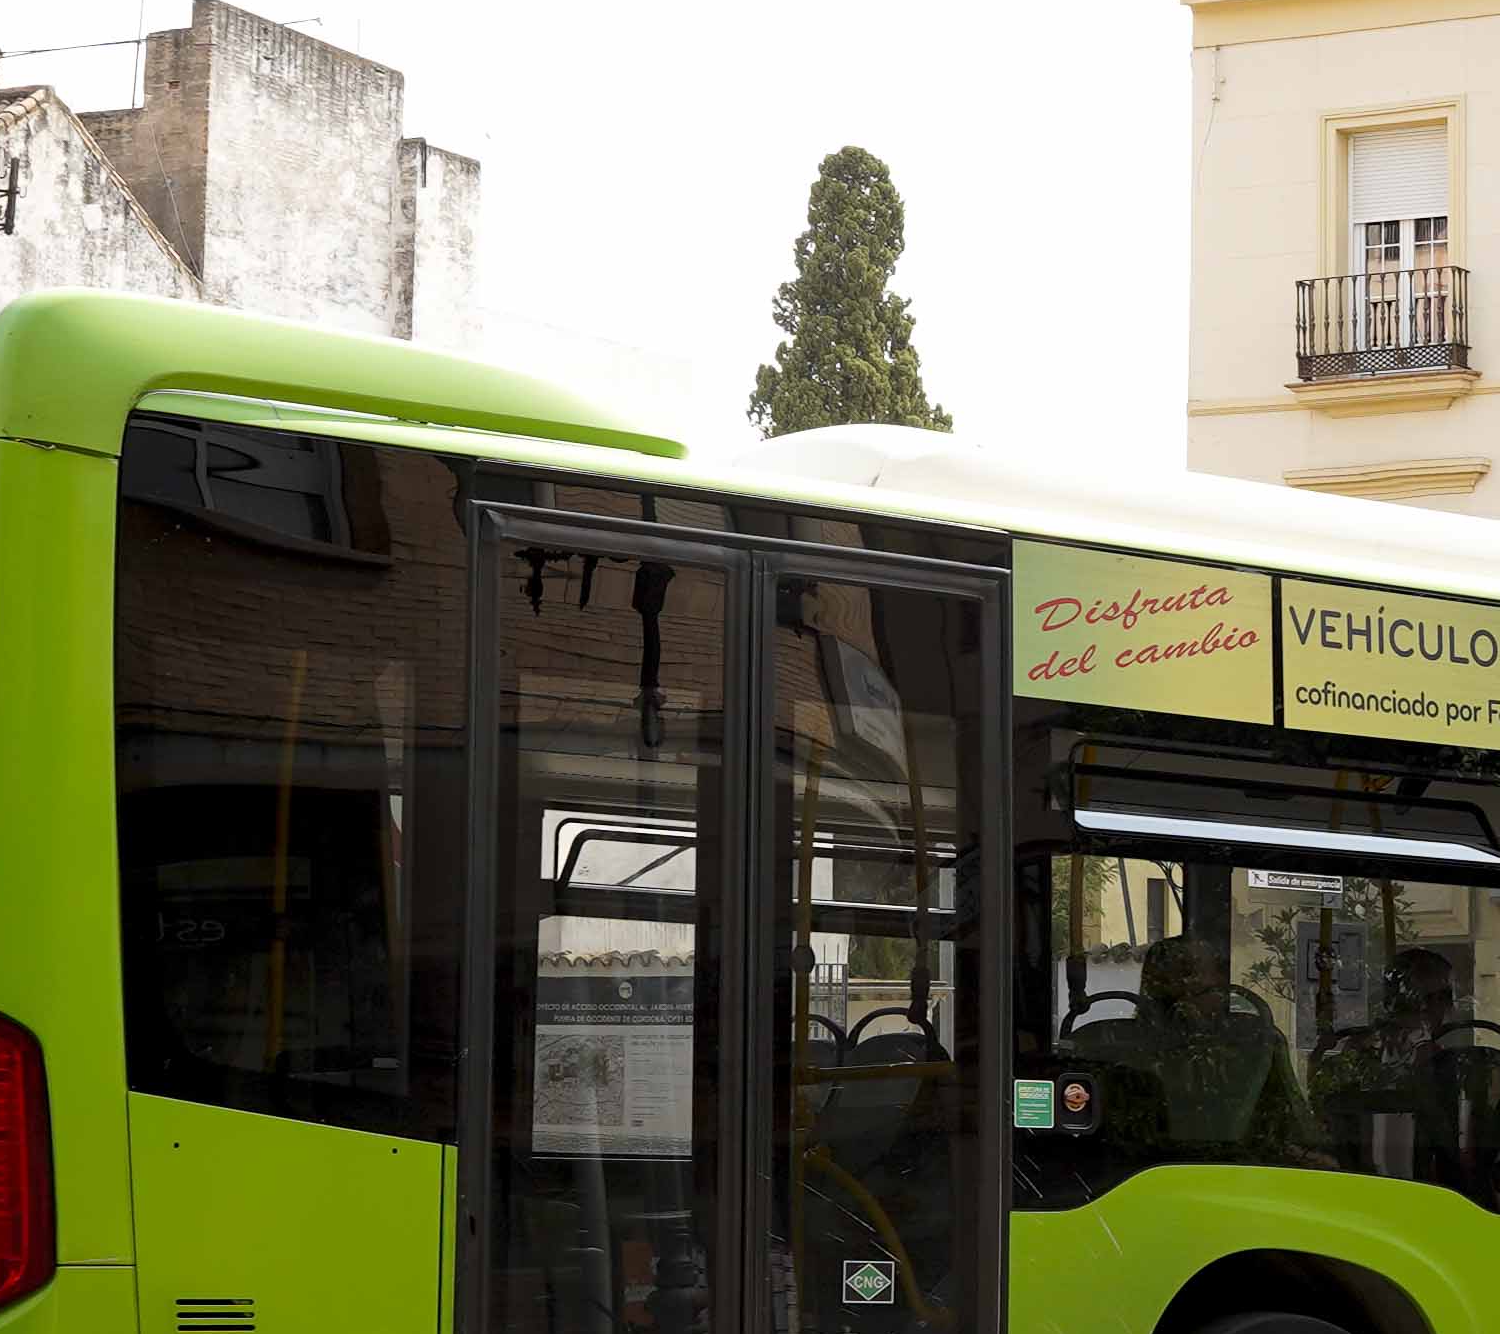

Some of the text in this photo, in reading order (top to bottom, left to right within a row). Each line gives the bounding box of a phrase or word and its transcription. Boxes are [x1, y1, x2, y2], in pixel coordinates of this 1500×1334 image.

[1034, 582, 1232, 636] Disfruta
[1028, 623, 1261, 686] del cambio
[1288, 605, 1499, 668] VEHÍCULO
[1296, 683, 1441, 721] cofinanciado
[1446, 703, 1483, 728] por
[854, 1276, 884, 1288] CNG
